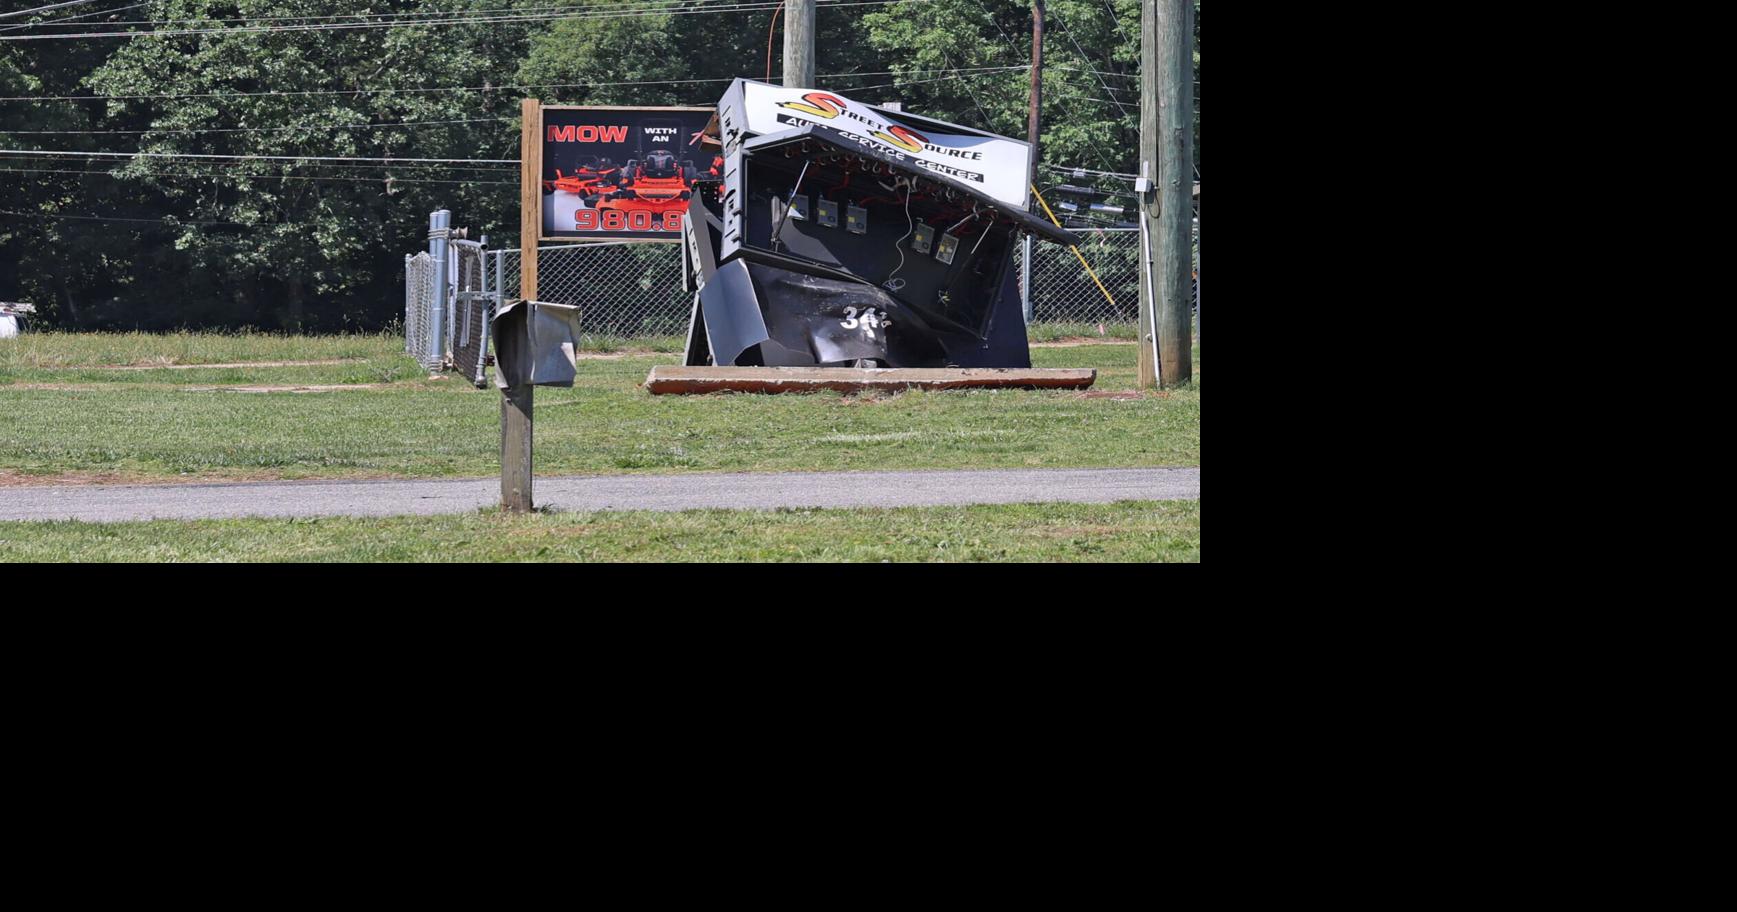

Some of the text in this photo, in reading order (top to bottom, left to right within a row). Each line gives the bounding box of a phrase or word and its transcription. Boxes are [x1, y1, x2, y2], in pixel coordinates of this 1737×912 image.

[547, 125, 629, 143] MOW
[644, 127, 677, 135] WITH
[775, 93, 983, 160] STREET SOURCE
[652, 135, 670, 143] AN
[915, 159, 980, 181] CENTER
